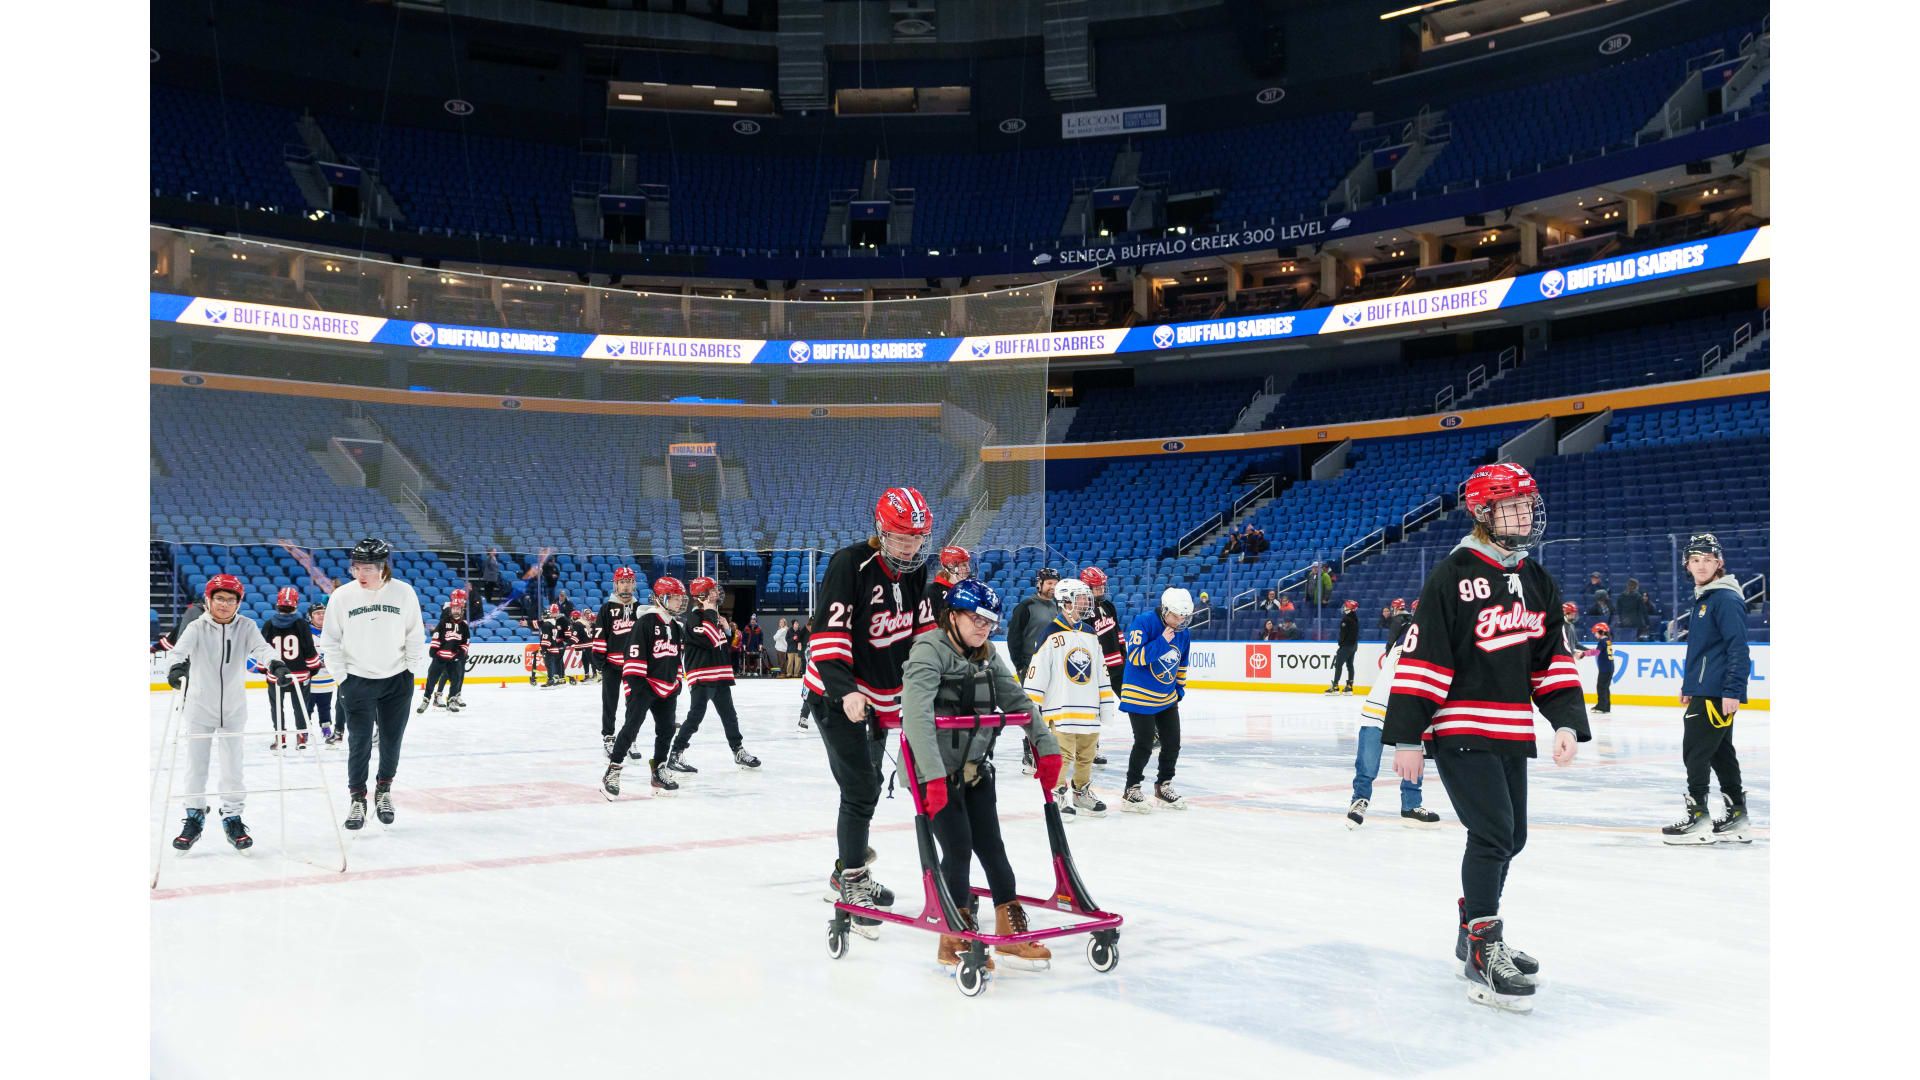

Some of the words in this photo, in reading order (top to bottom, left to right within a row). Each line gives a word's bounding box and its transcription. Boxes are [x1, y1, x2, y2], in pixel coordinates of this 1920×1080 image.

[1608, 38, 1622, 51] 318
[741, 122, 753, 132] 315
[1067, 114, 1120, 129] LECOM
[1059, 249, 1116, 264] SENECA
[1121, 239, 1186, 259] BUFFALO
[1191, 232, 1240, 252] CREEK
[1243, 228, 1275, 245] 300
[1281, 220, 1325, 240] LEVEL
[1567, 259, 1636, 291] BUFFALO
[1637, 246, 1705, 277] SABRES
[1366, 297, 1428, 321] BUFFALO
[1430, 289, 1488, 313] SABRES
[233, 306, 299, 329] BUFFALO
[302, 316, 360, 336] SABRES
[1176, 321, 1236, 344] BUFFALO
[1237, 317, 1293, 338] SABRES
[437, 328, 500, 349] BUFFALO
[500, 333, 556, 352] SABRES
[994, 338, 1051, 355] BUFFALO
[1053, 335, 1105, 352] SABRES
[630, 341, 687, 357] BUFFALO
[690, 343, 741, 359] SABRES
[812, 343, 871, 360] BUFFALO
[871, 343, 924, 360] SABRES
[911, 511, 925, 522] 22
[1459, 577, 1491, 602] 96
[348, 604, 381, 618] MICHIGAN
[382, 604, 401, 616] STATE
[610, 608, 621, 617] 17
[654, 625, 661, 636] 5
[271, 634, 300, 661] 19
[1051, 634, 1066, 649] 30
[629, 644, 640, 659] 5
[466, 654, 522, 673] gmans
[1277, 654, 1337, 670] TOYOTA
[1637, 658, 1765, 681] FANL
